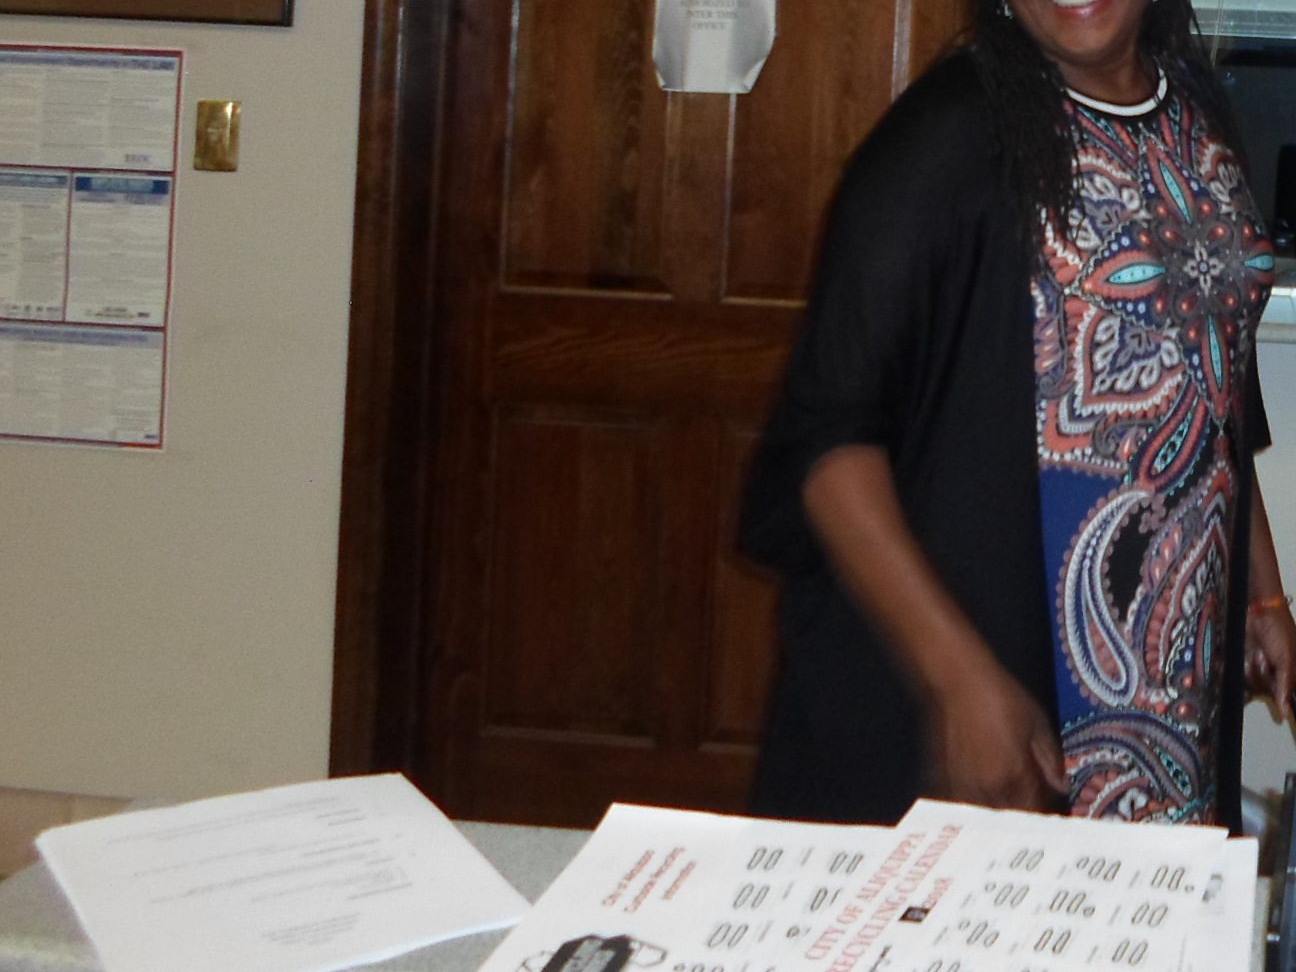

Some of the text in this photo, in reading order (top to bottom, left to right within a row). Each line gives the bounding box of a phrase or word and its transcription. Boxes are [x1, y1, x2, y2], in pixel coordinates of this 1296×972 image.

[805, 832, 926, 960] CITY OF ALIQUIPPA
[895, 825, 964, 894] CALENDAR
